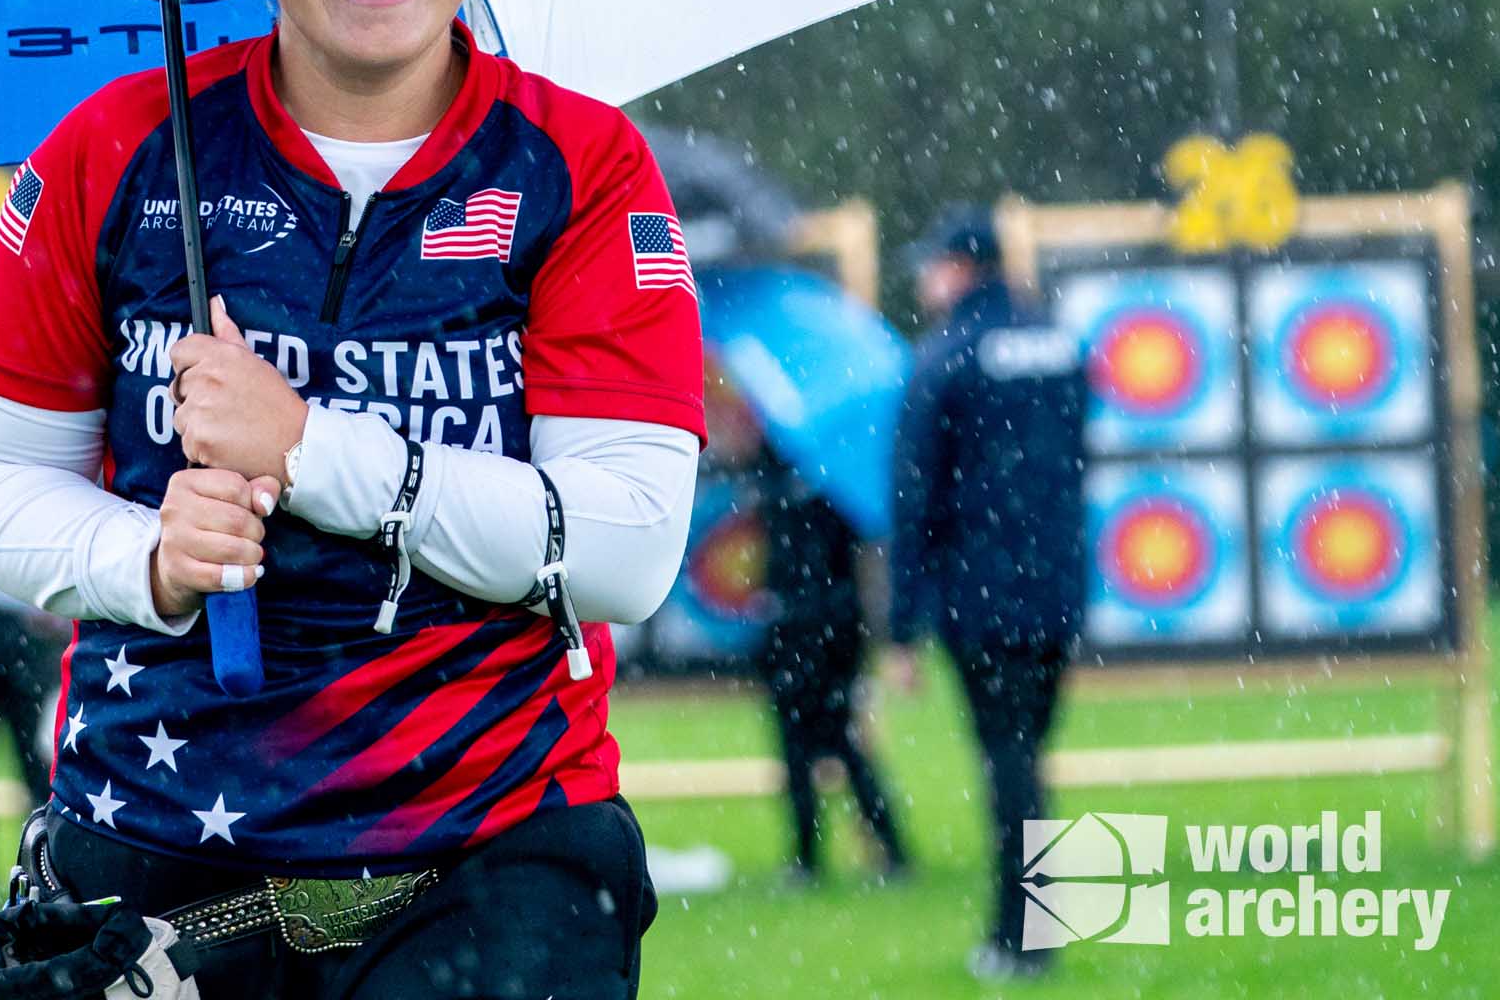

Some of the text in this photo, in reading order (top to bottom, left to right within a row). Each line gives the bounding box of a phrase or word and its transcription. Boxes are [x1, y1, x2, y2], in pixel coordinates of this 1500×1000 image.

[143, 195, 278, 218] UNID STATES
[227, 213, 276, 232] TEAM
[334, 330, 525, 400] STATES
